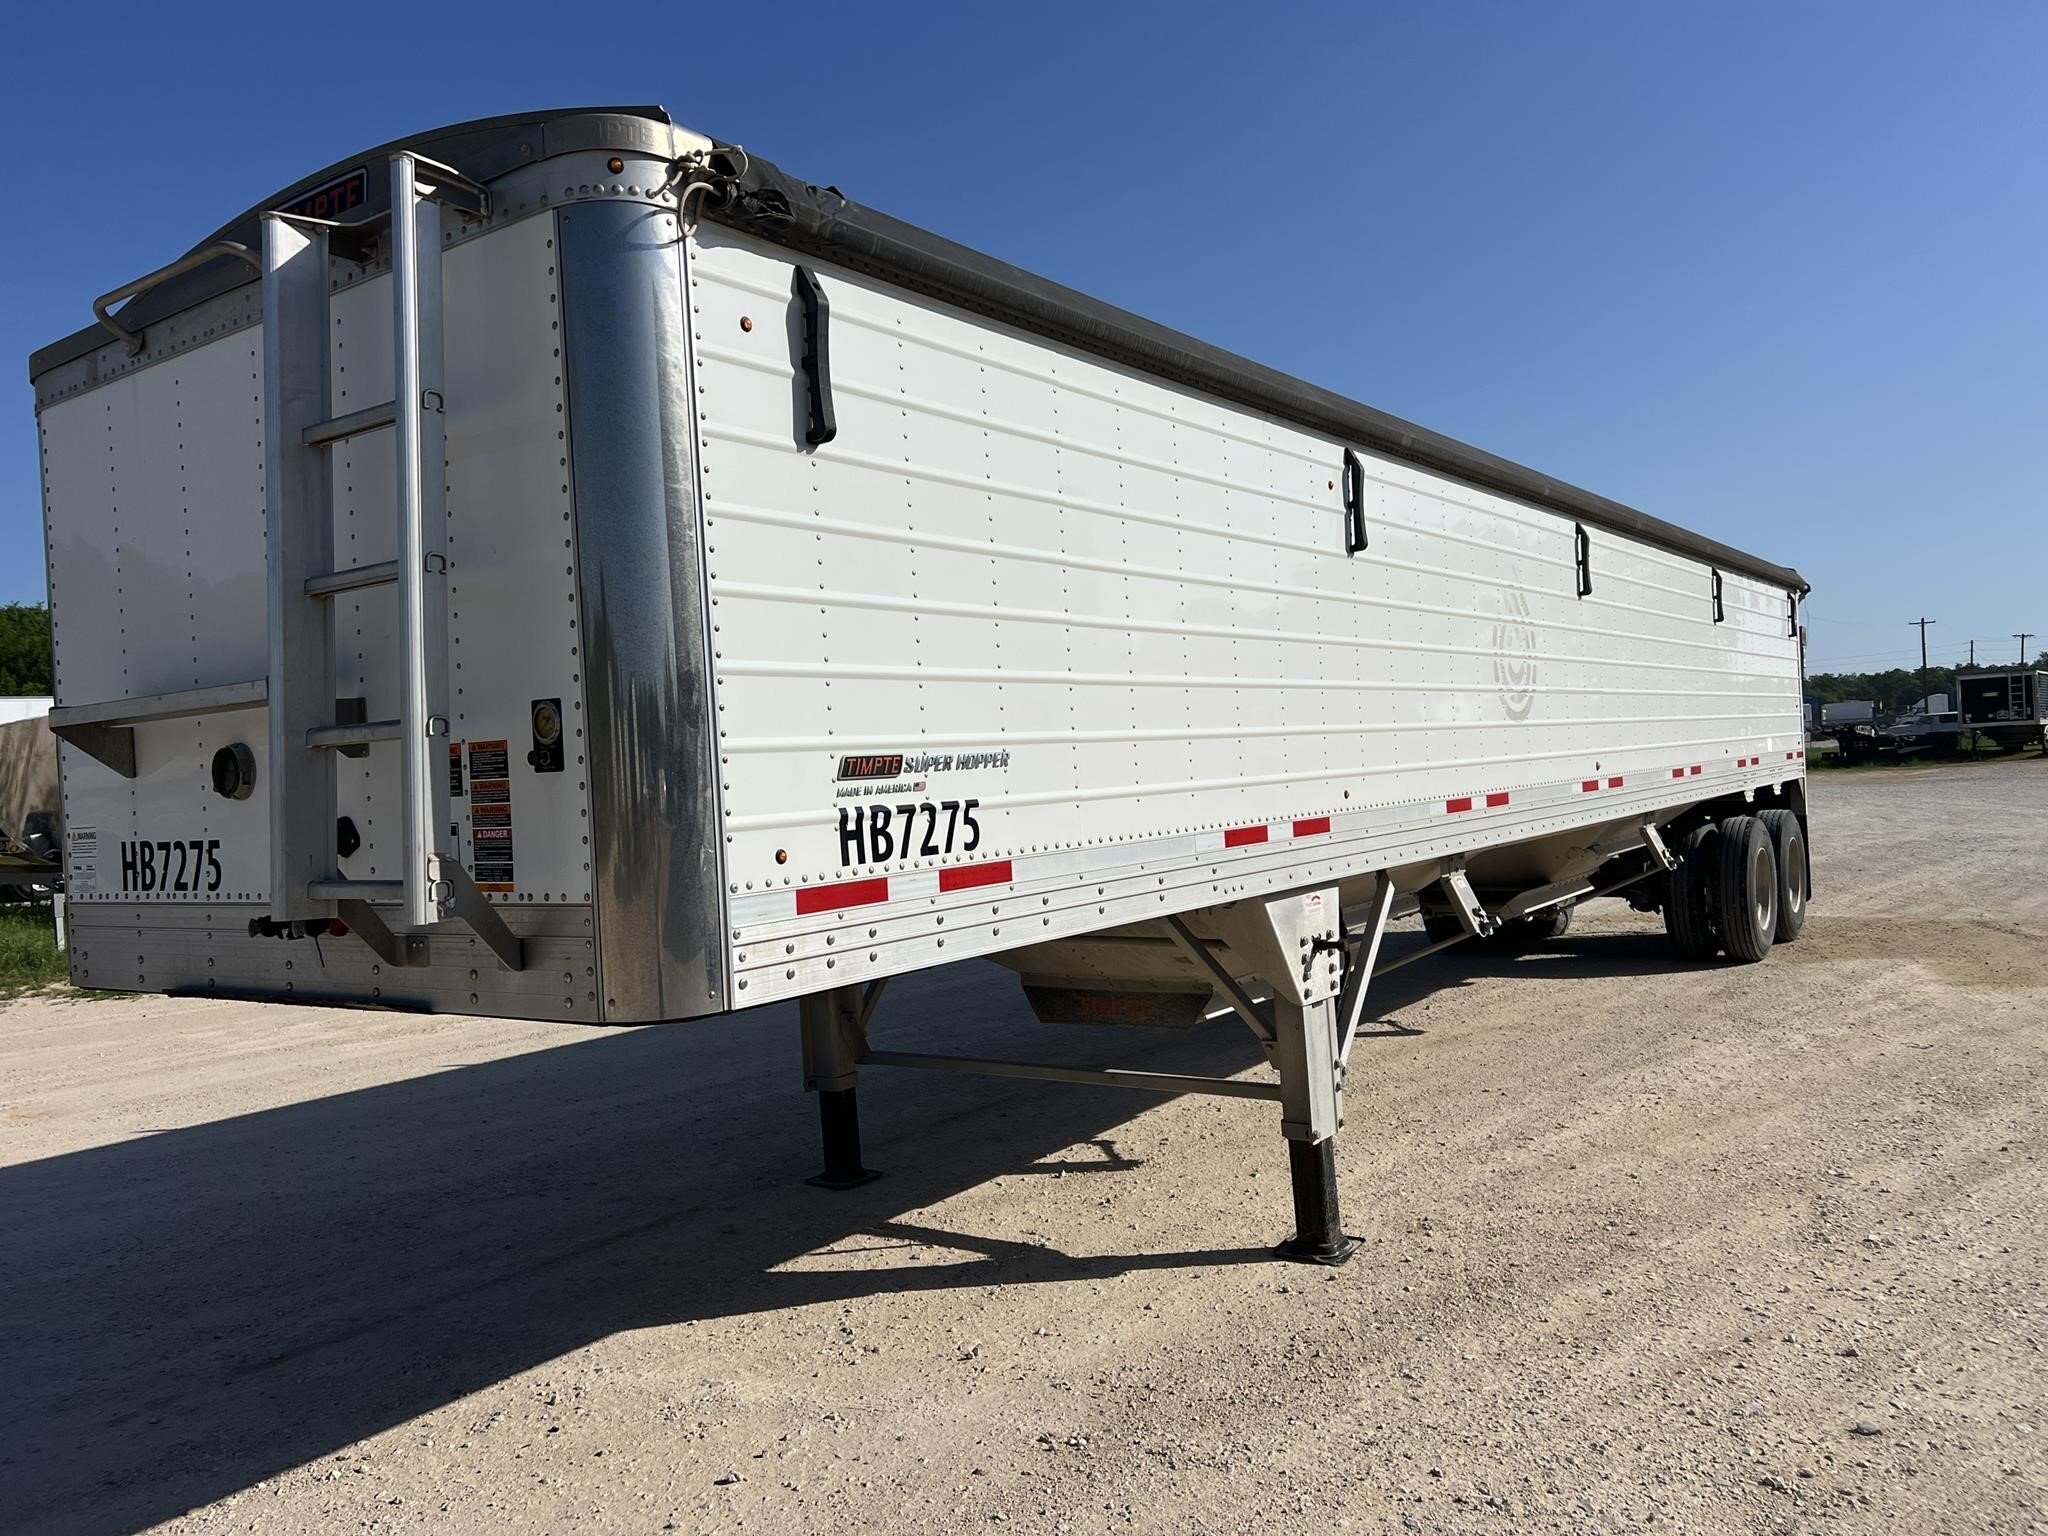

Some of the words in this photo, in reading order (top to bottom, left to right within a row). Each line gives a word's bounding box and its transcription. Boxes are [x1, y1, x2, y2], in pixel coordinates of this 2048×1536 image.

[847, 756, 901, 776] TIMPTE
[903, 755, 953, 773] SUPER
[956, 752, 1010, 770] HOPPER
[836, 787, 862, 798] MADE
[864, 785, 874, 796] IN
[875, 783, 912, 795] AMERICA
[482, 830, 508, 839] DANGER
[838, 799, 980, 866] HB7275
[121, 840, 222, 892] HB7275
